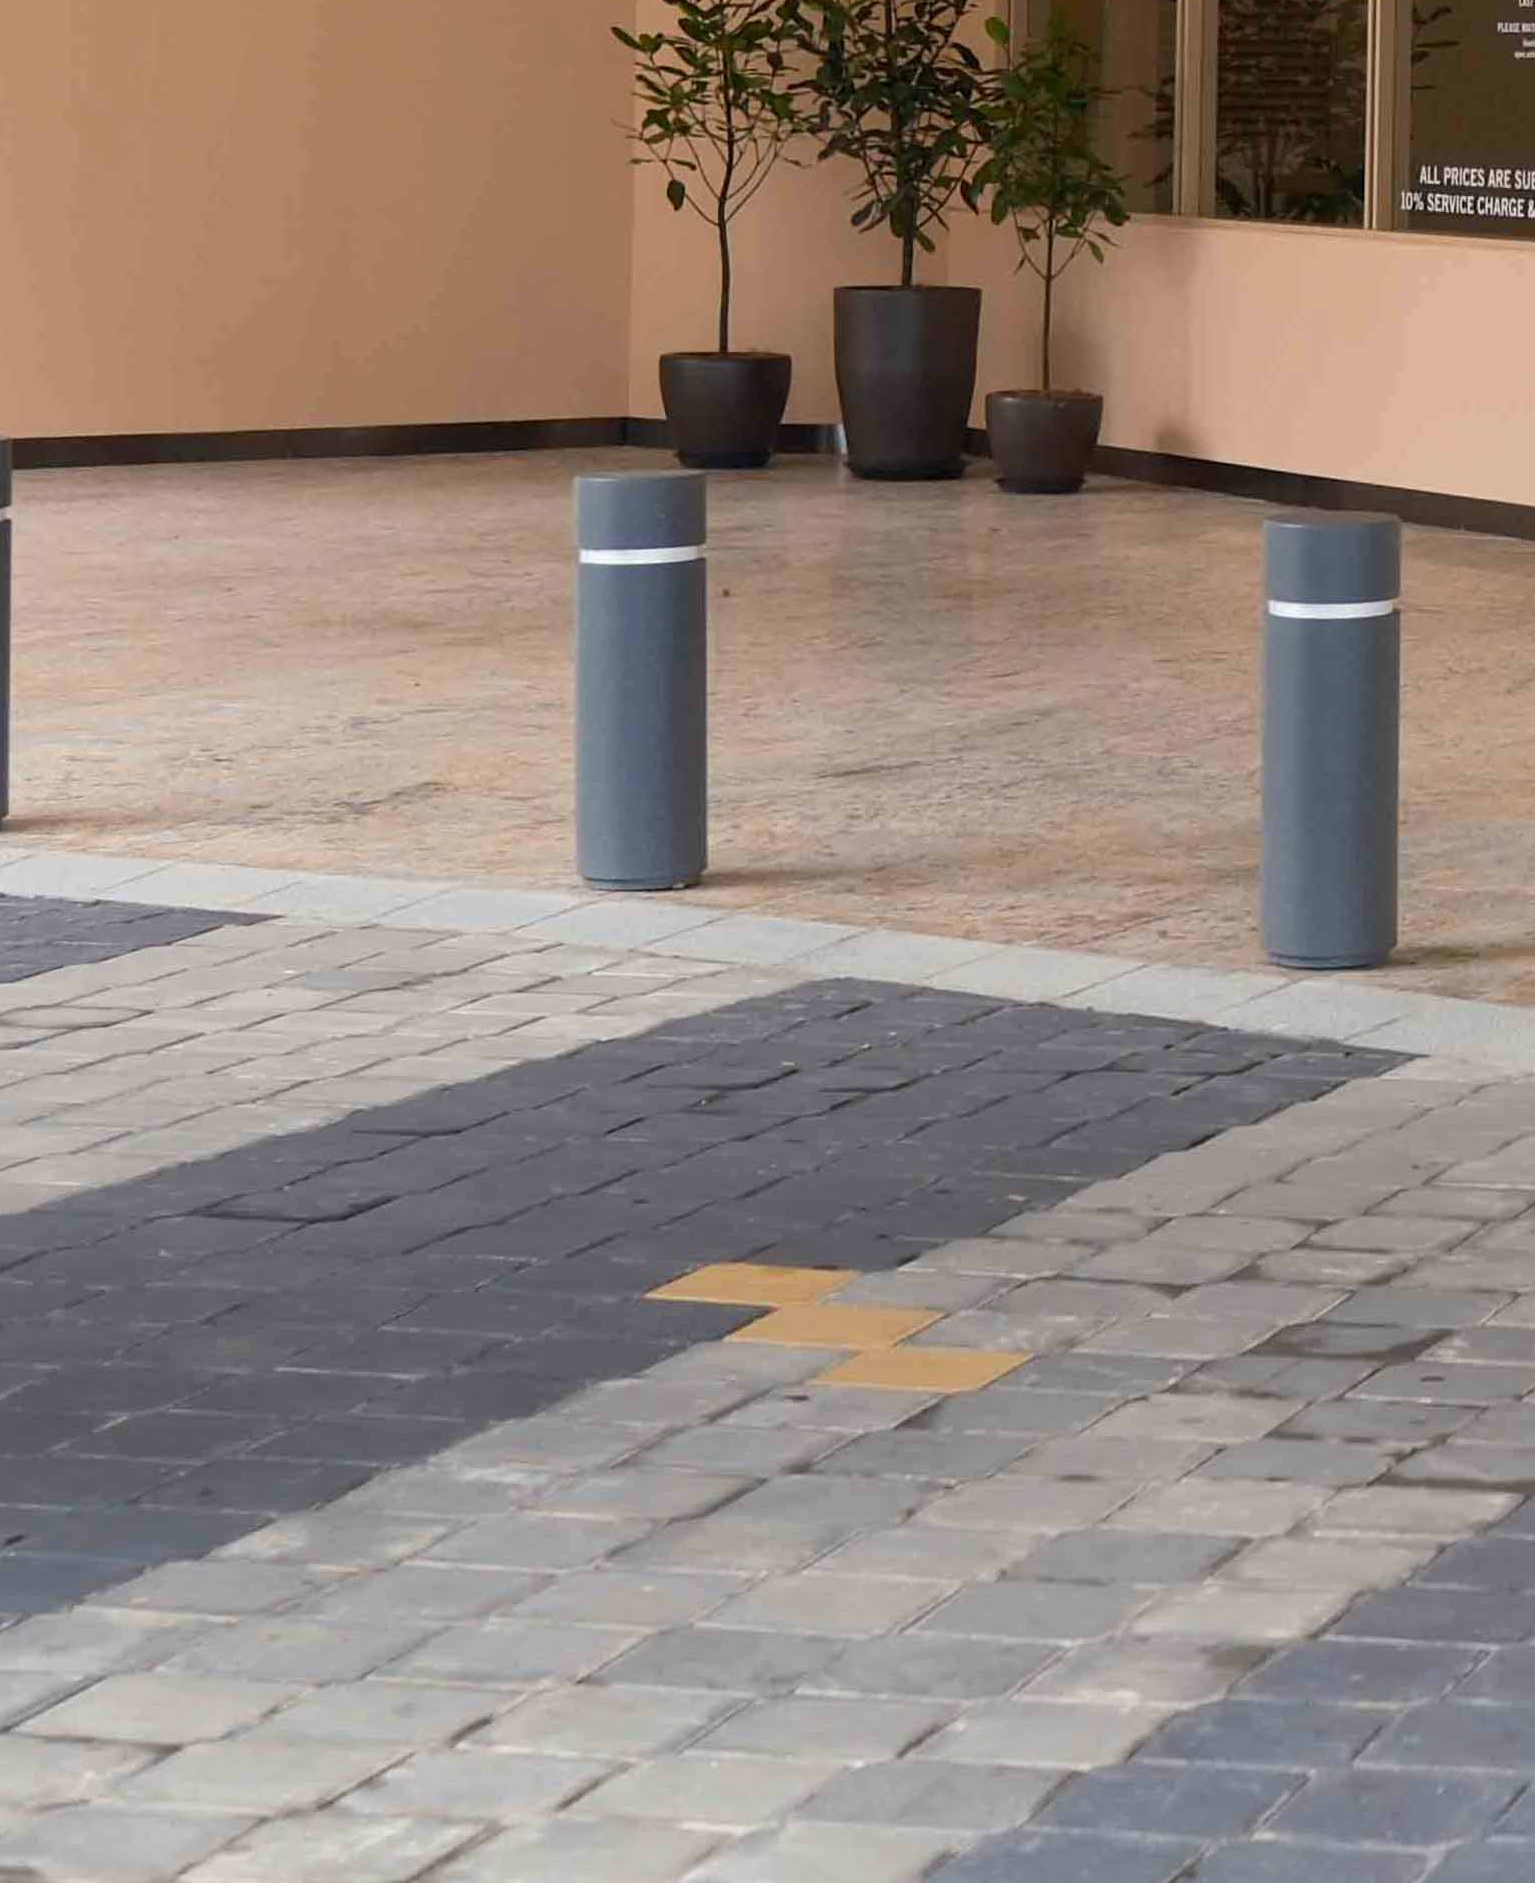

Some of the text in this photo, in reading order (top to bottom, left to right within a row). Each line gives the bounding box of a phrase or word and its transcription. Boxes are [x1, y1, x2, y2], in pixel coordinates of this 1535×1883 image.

[1497, 22, 1520, 33] PLEASE
[1419, 165, 1441, 185] ALL
[1443, 167, 1485, 187] PRICES
[1487, 168, 1512, 188] ARE
[1400, 191, 1424, 211] 10%
[1427, 192, 1475, 214] SERVICE
[1477, 196, 1524, 218] CHARGE
